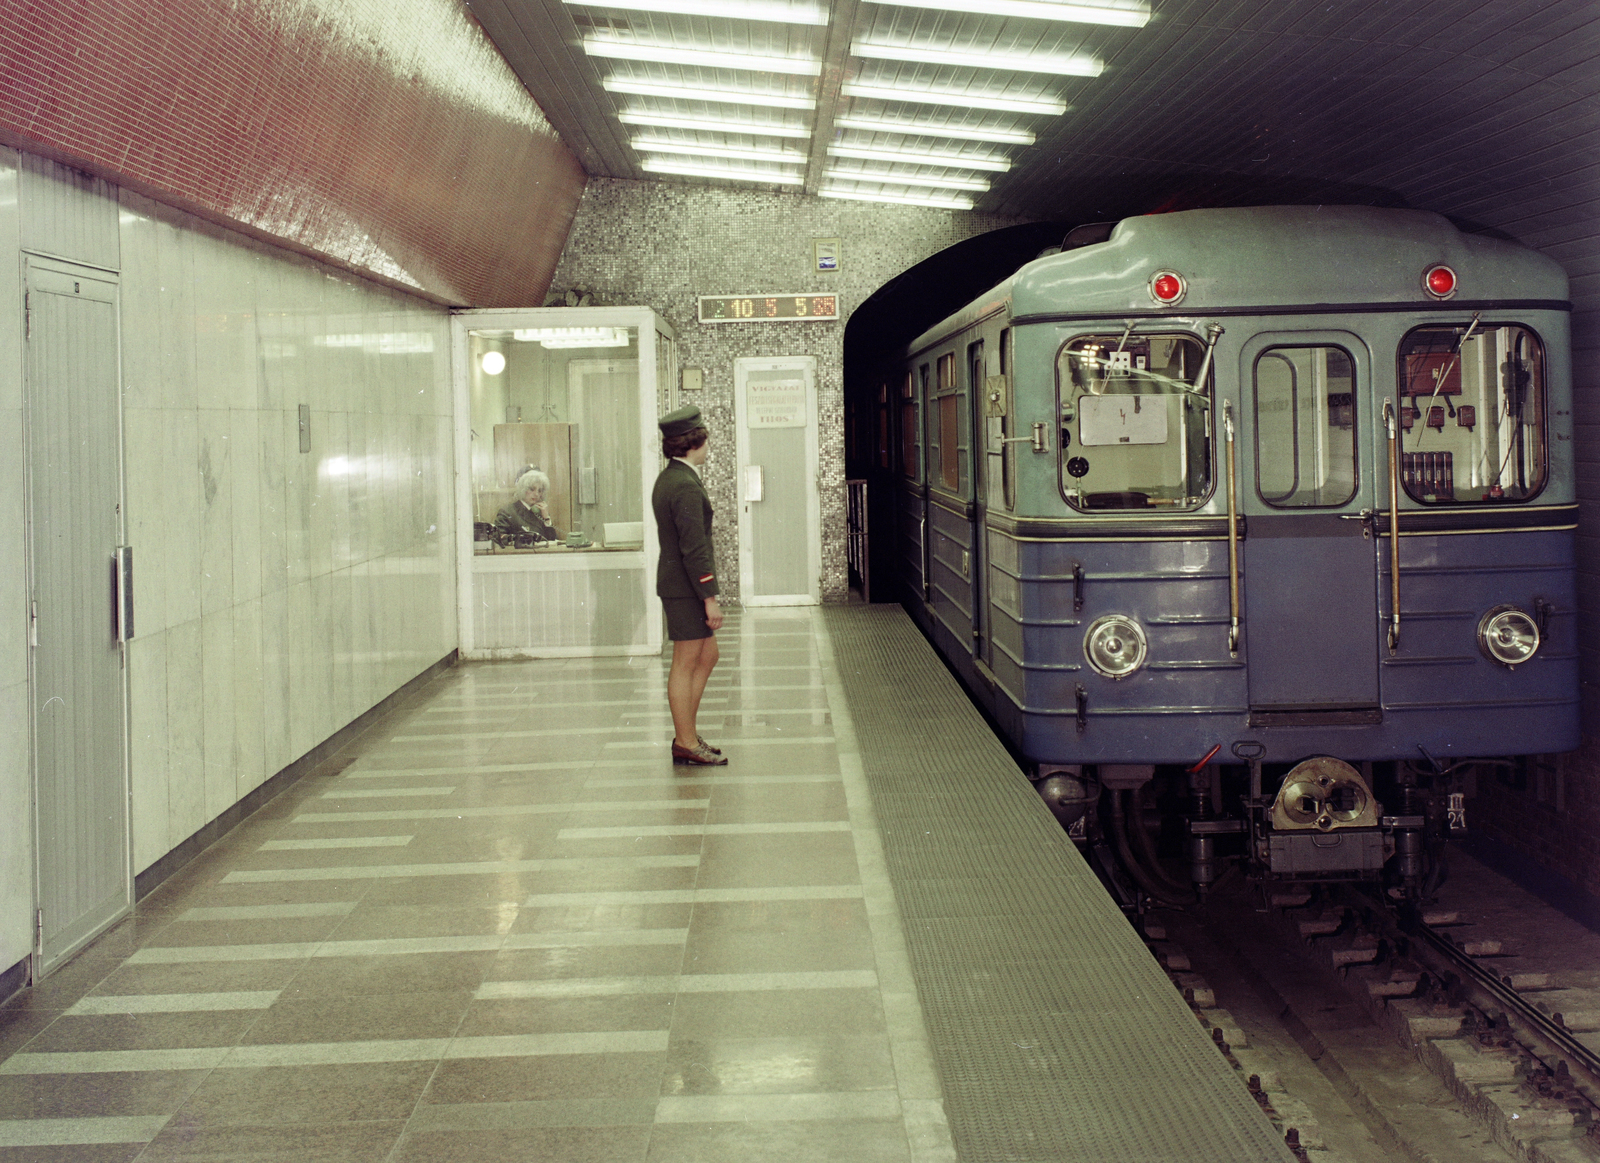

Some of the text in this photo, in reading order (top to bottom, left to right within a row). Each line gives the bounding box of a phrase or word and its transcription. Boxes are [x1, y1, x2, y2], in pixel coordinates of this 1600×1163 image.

[714, 300, 725, 318] 2
[731, 299, 753, 318] 10
[766, 298, 777, 317] 5
[795, 297, 807, 316] 5
[1447, 811, 1466, 829] 21
